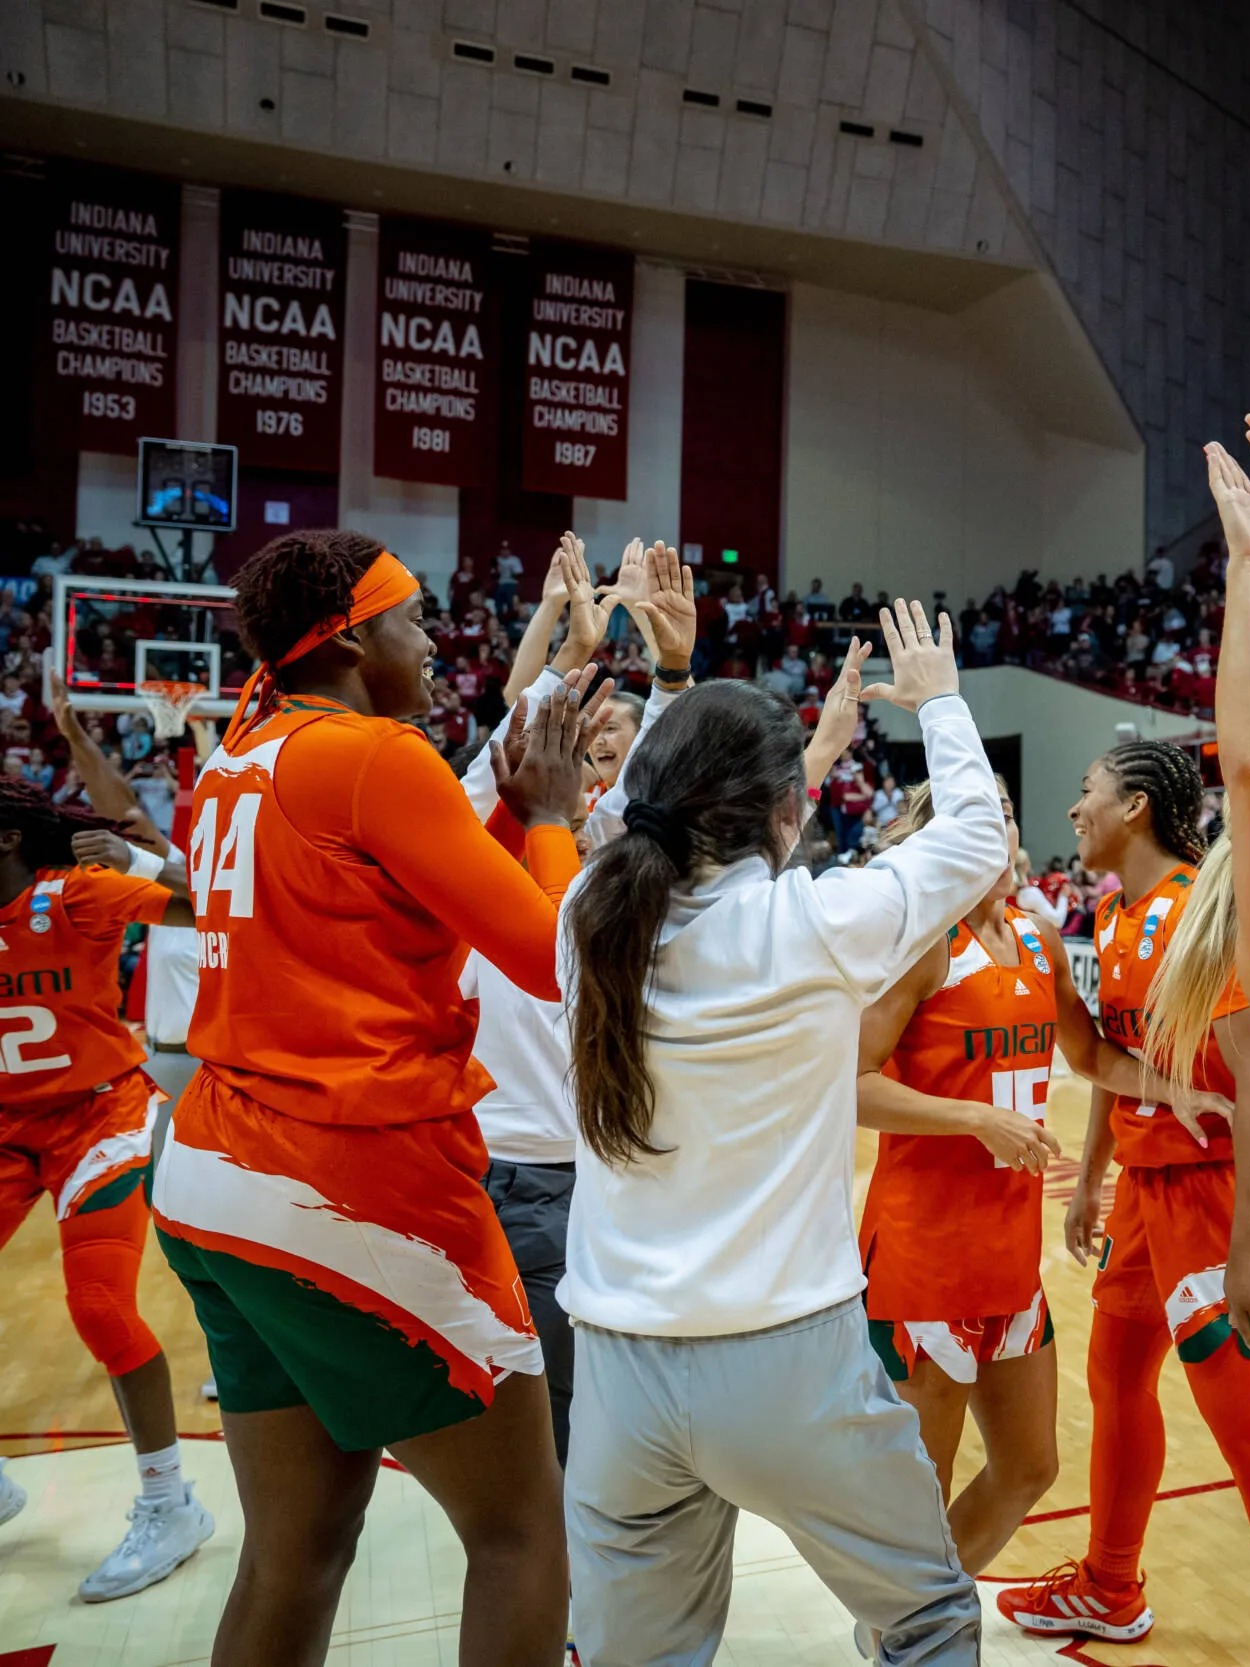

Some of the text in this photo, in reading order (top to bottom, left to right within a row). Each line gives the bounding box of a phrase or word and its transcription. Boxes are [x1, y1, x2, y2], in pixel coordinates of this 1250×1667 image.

[70, 201, 158, 238] INDIANA
[55, 230, 170, 270] UNIVERSITY
[243, 228, 323, 261] INDIANA
[228, 256, 335, 291] UNIVERSITY
[398, 252, 473, 283] INDIANA
[51, 267, 172, 322] NCAA
[385, 277, 483, 313] UNIVERSITY
[546, 273, 615, 303] INDIANA
[223, 292, 336, 340] NCAA
[533, 299, 625, 331] UNIVERSITY
[53, 319, 167, 357] BASKETBALL
[381, 311, 484, 360] NCAA
[57, 351, 163, 387] CHAMPIONS
[225, 341, 332, 376] BASKETBALL
[528, 331, 626, 377] NCAA
[229, 370, 327, 404] CHAMPIONS
[382, 358, 479, 394] BASKETBALL
[530, 376, 622, 410] BASKETBALL
[83, 391, 136, 420] 1953
[386, 388, 475, 421] CHAMPIONS
[533, 405, 618, 437] CHAMPIONS
[256, 410, 304, 436] 1976
[412, 426, 450, 453] 1981
[555, 441, 597, 468] 1987
[190, 793, 262, 918] 44
[0, 1005, 72, 1075] 2
